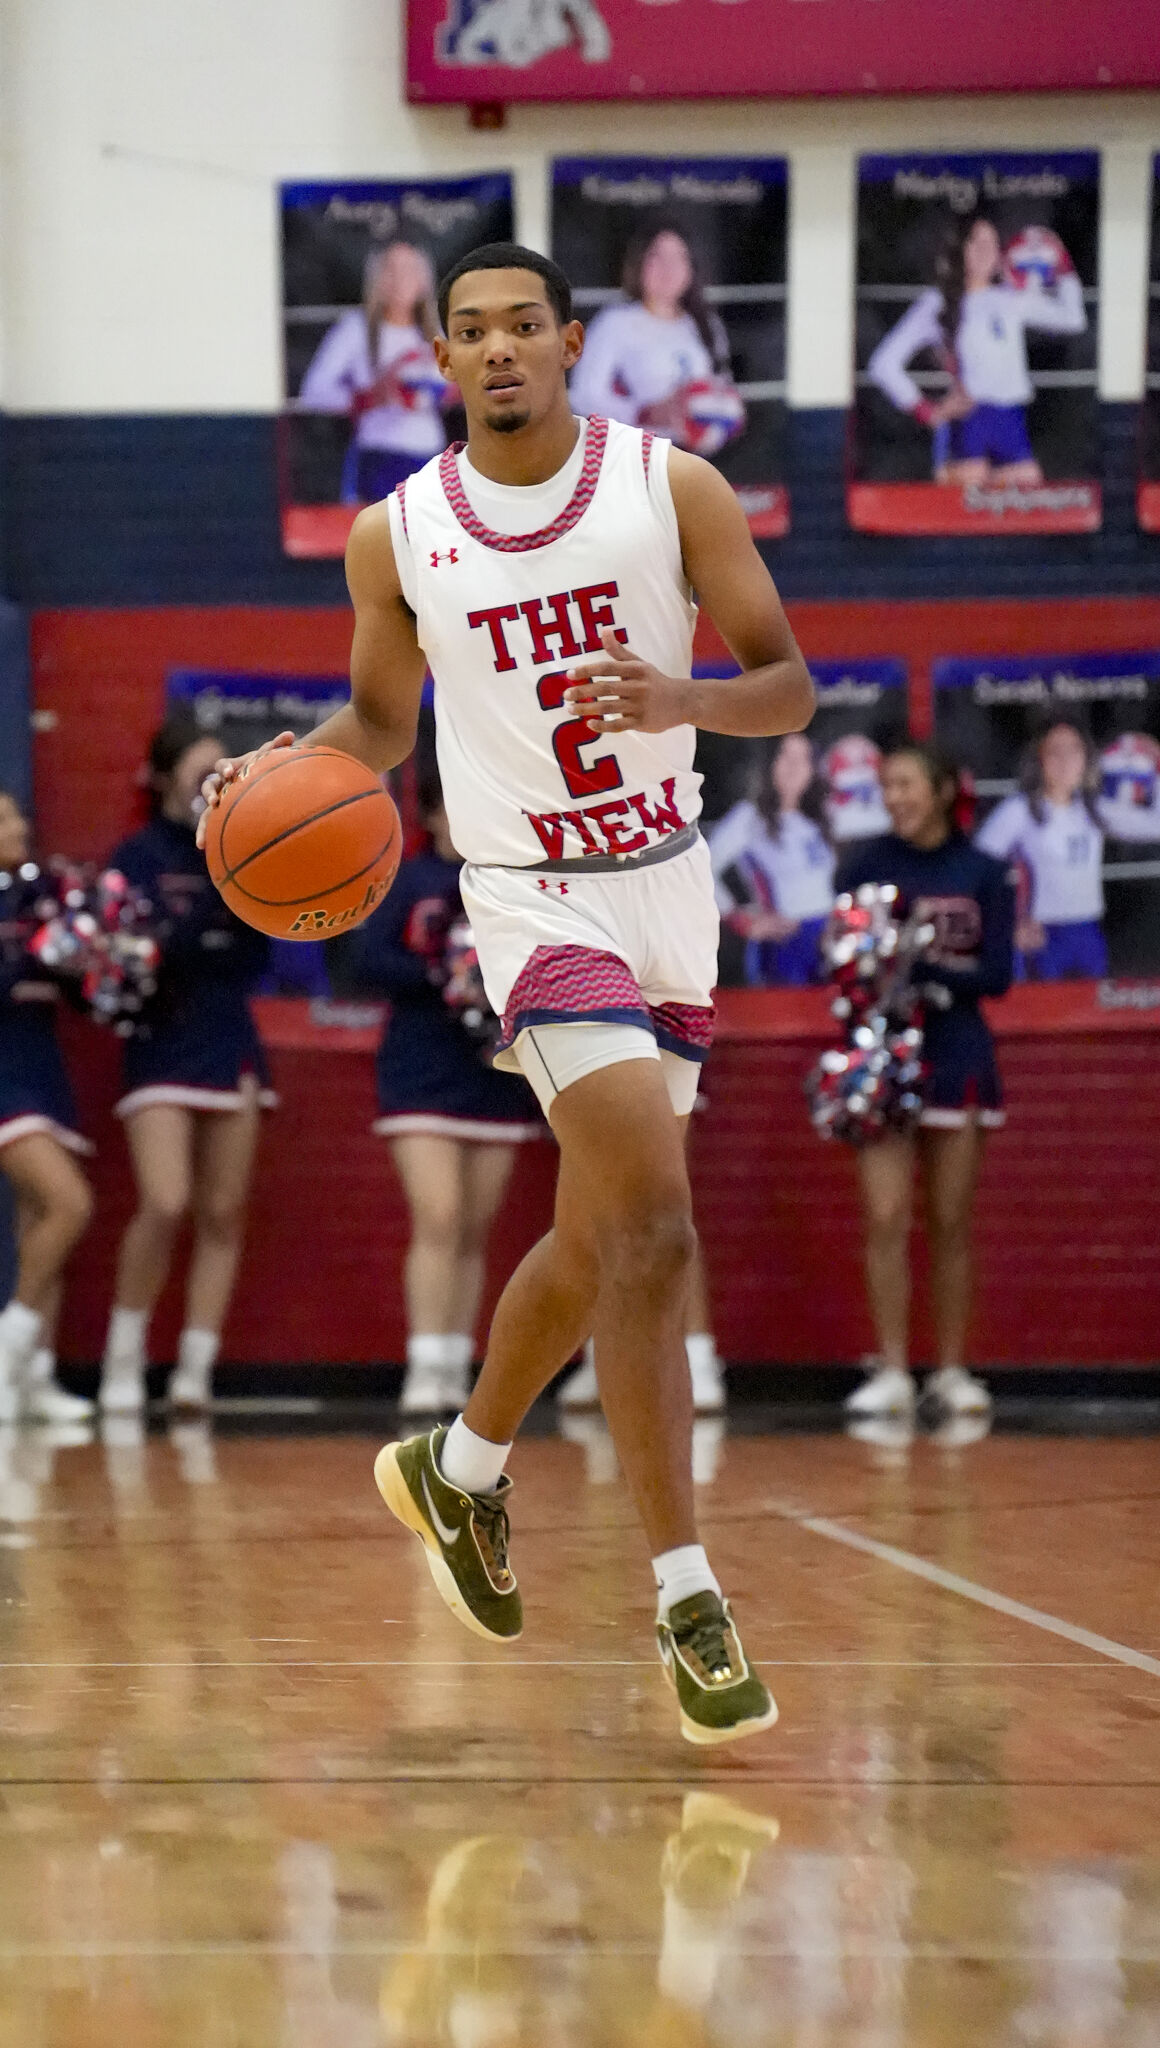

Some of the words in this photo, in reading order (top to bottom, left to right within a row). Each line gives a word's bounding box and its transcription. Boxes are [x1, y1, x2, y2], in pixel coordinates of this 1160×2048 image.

[466, 580, 629, 673] THE
[536, 669, 624, 799] 2
[521, 777, 687, 860] VIEW
